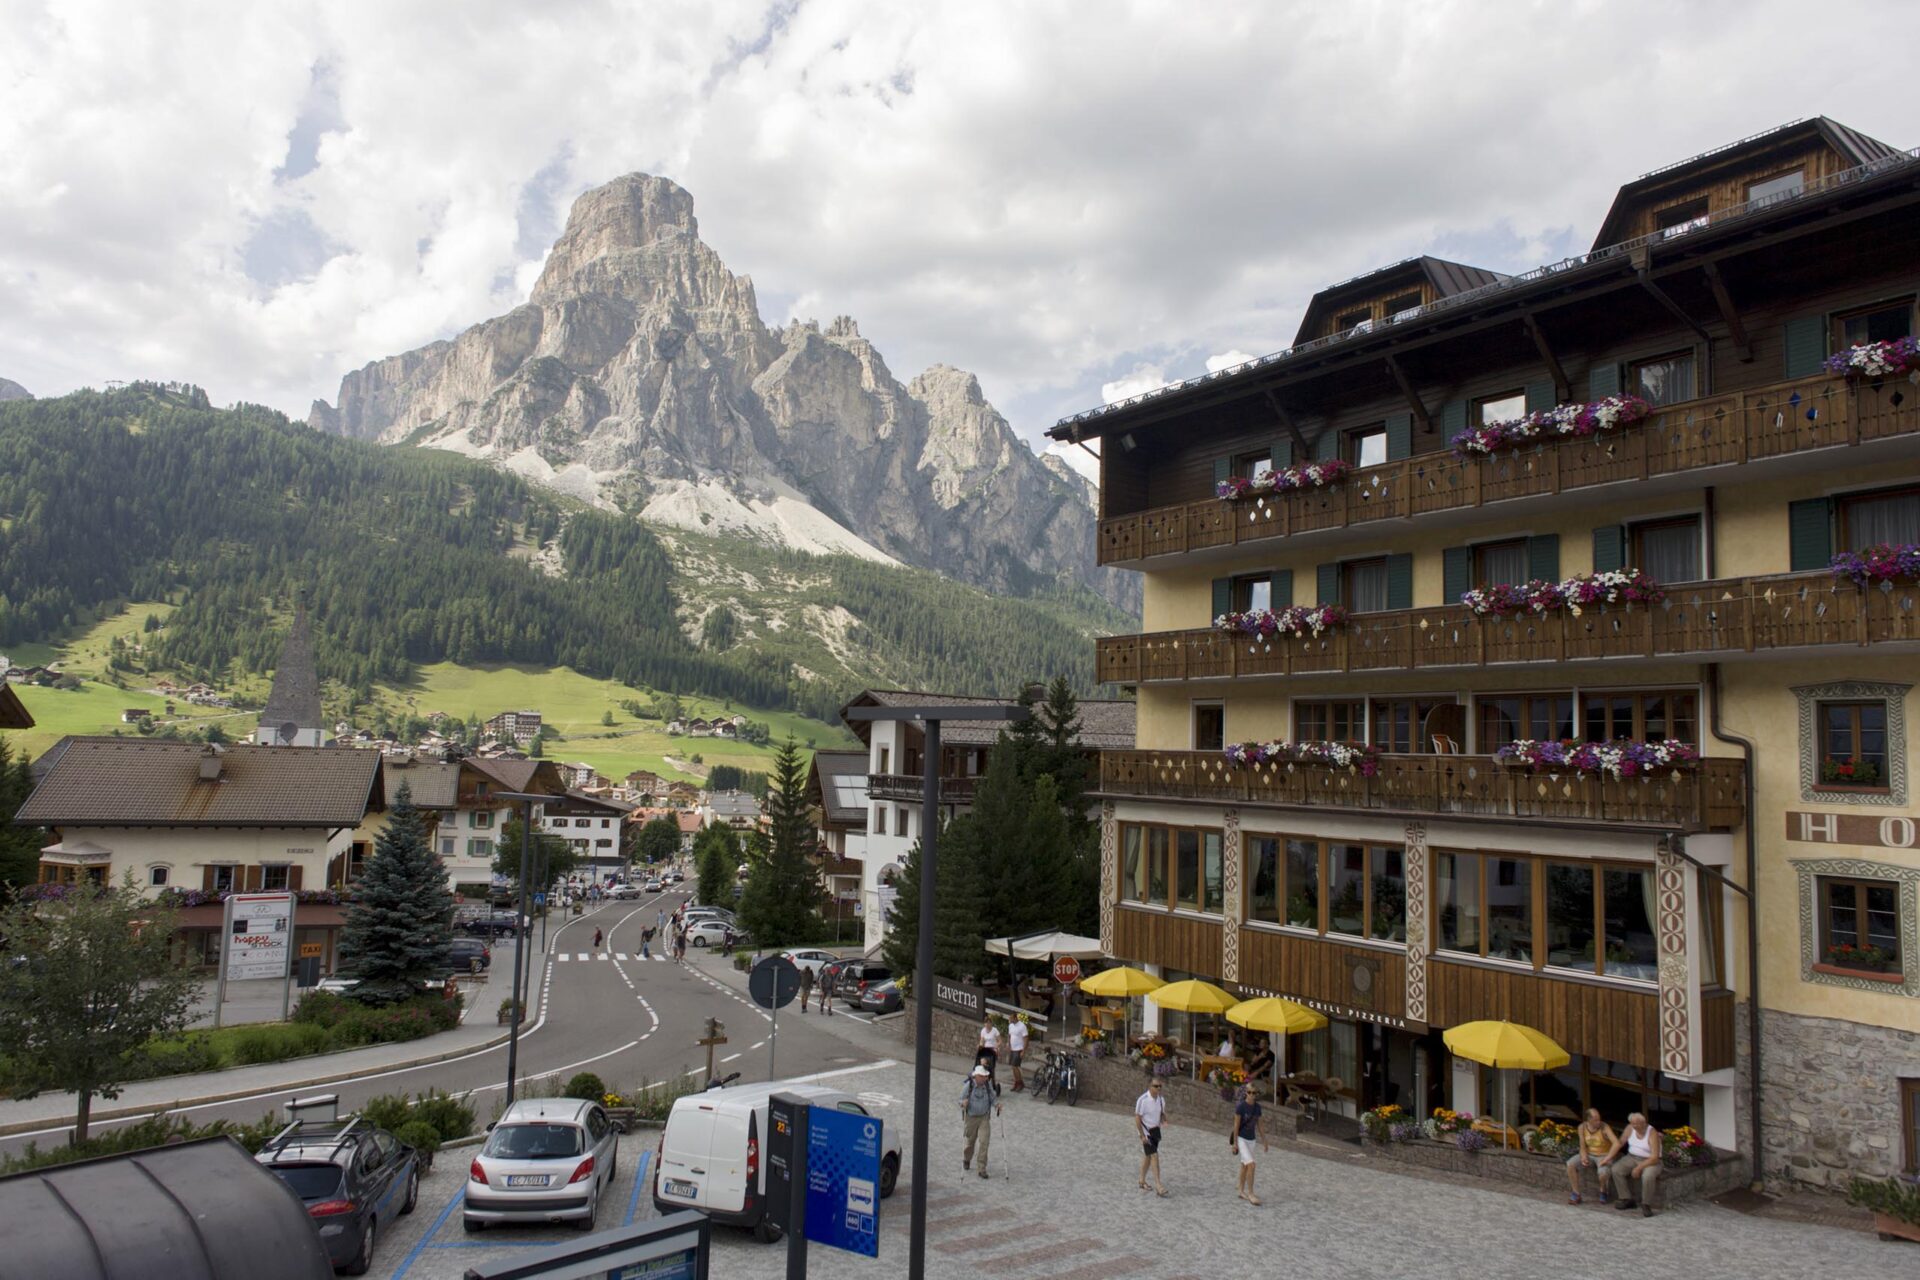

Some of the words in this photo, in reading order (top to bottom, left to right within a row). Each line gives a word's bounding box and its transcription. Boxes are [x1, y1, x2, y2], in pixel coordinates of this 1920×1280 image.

[1055, 964, 1078, 976] STOP
[936, 983, 978, 1009] taverna
[1308, 1000, 1341, 1015] GRILL
[1348, 1009, 1405, 1028] PIZZERIA
